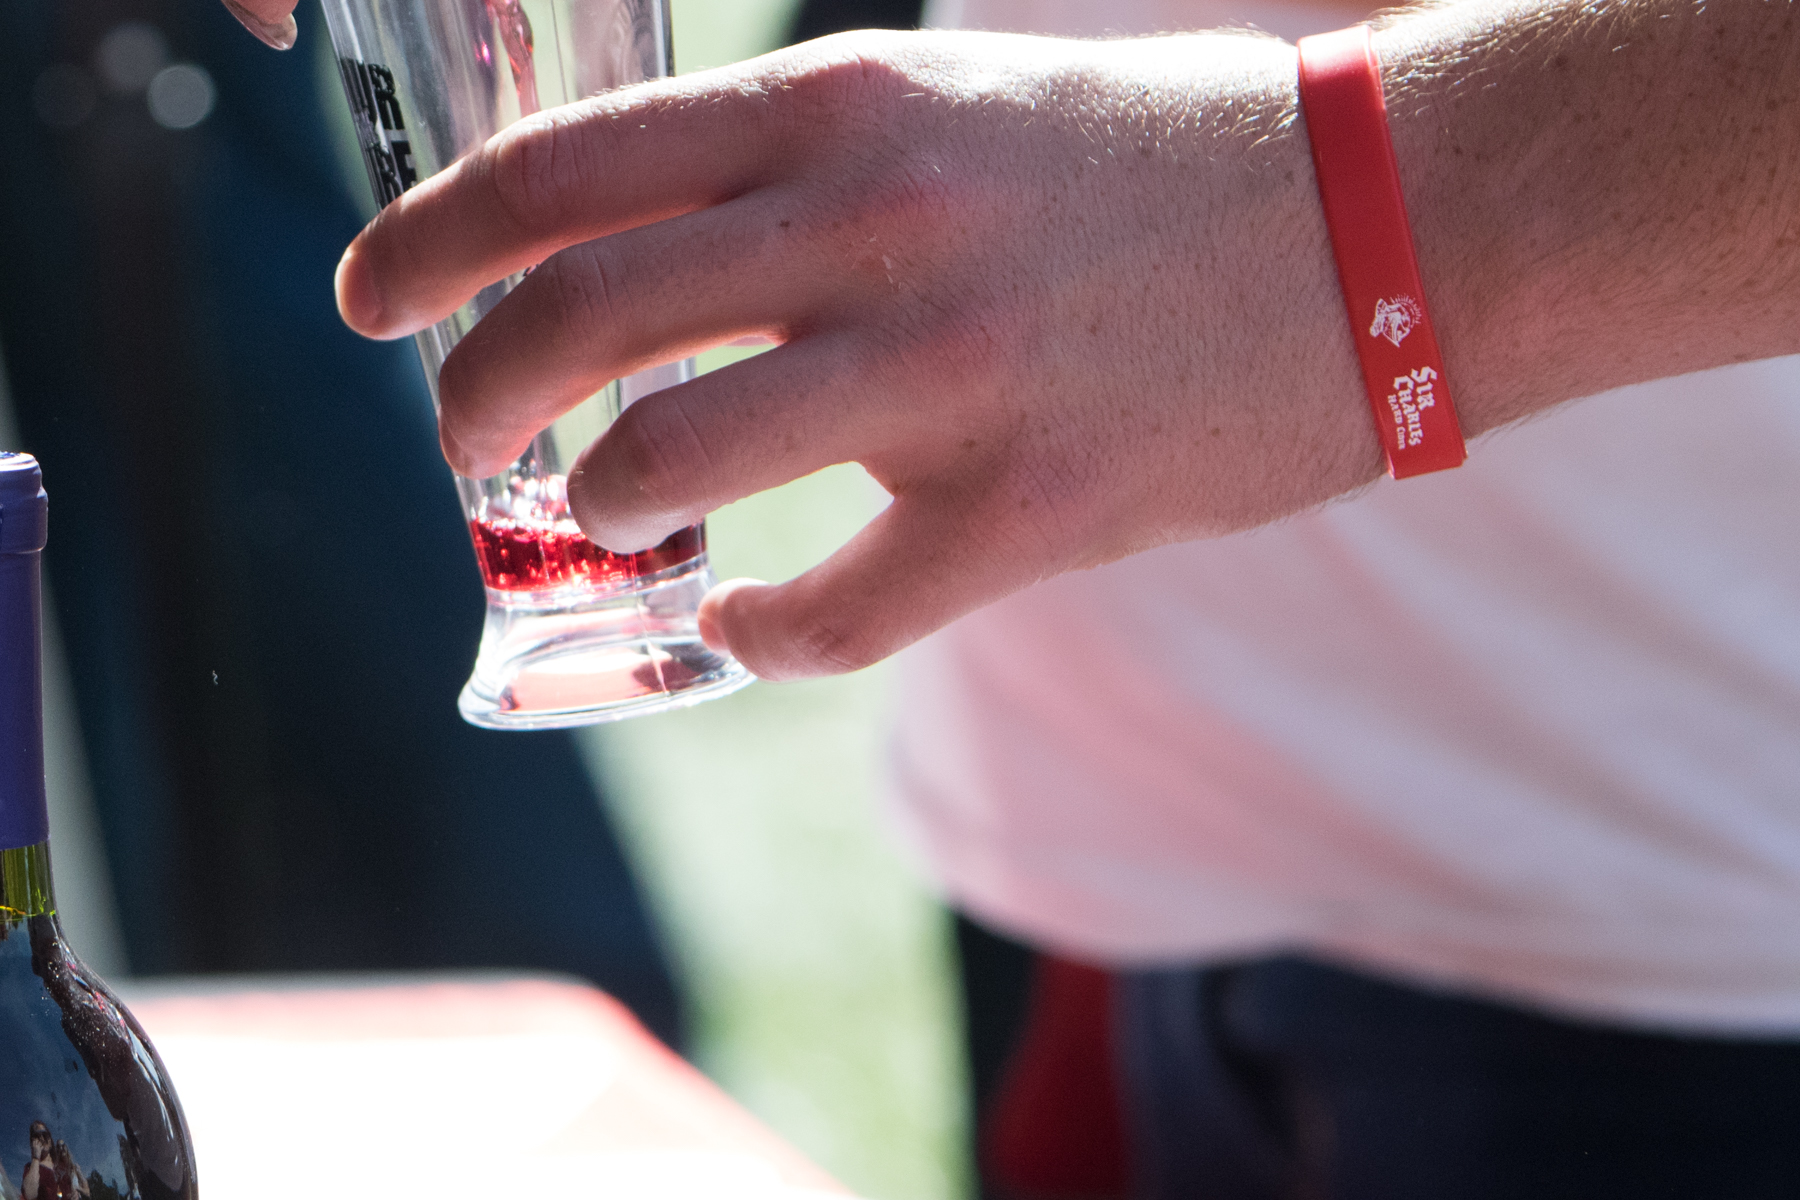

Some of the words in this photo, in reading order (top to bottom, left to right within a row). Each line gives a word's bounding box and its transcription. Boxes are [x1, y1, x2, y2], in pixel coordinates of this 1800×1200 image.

[1387, 394, 1404, 424] HARD
[1410, 366, 1438, 410] SIR
[1393, 375, 1424, 446] CHARLES
